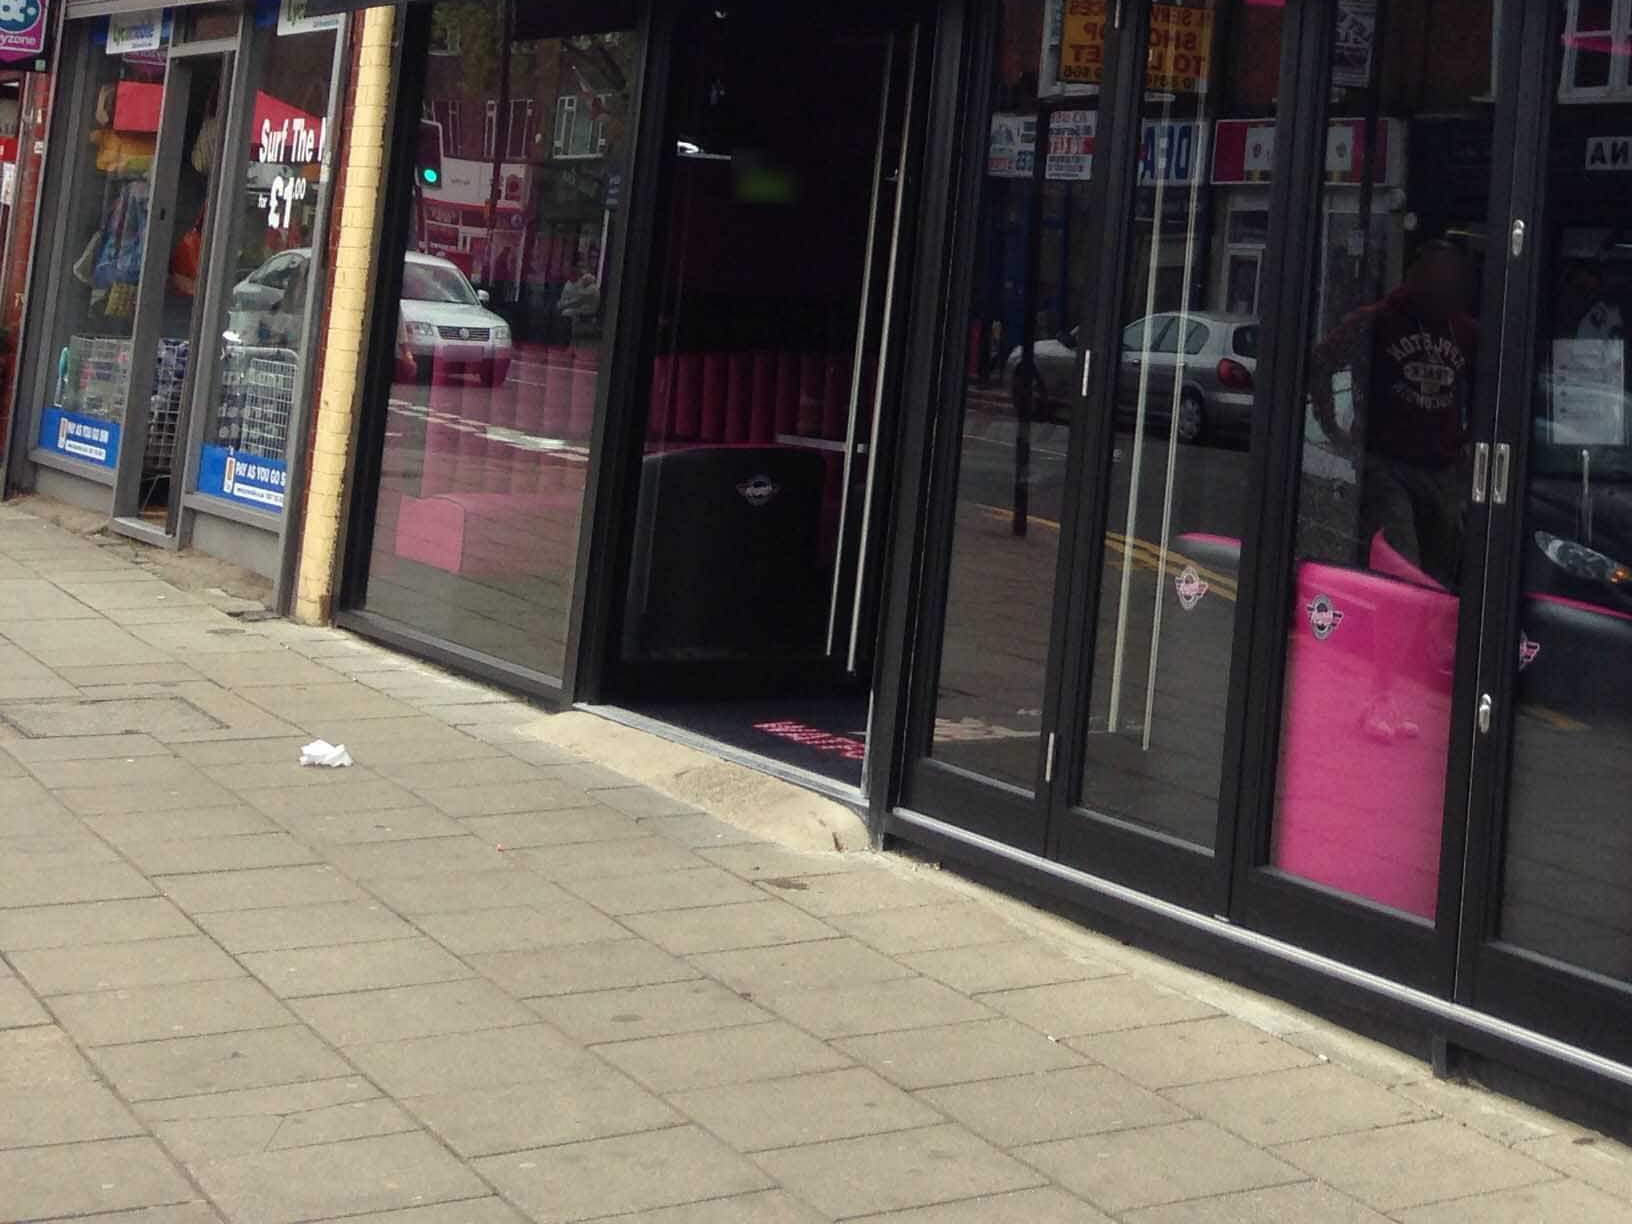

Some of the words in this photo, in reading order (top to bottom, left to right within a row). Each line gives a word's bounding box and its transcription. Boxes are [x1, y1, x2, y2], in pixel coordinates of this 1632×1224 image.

[259, 119, 288, 163] Surf
[291, 118, 313, 162] The
[235, 461, 246, 476] PAY
[247, 464, 256, 479] AS
[256, 466, 270, 482] YOU
[270, 469, 280, 484] GO
